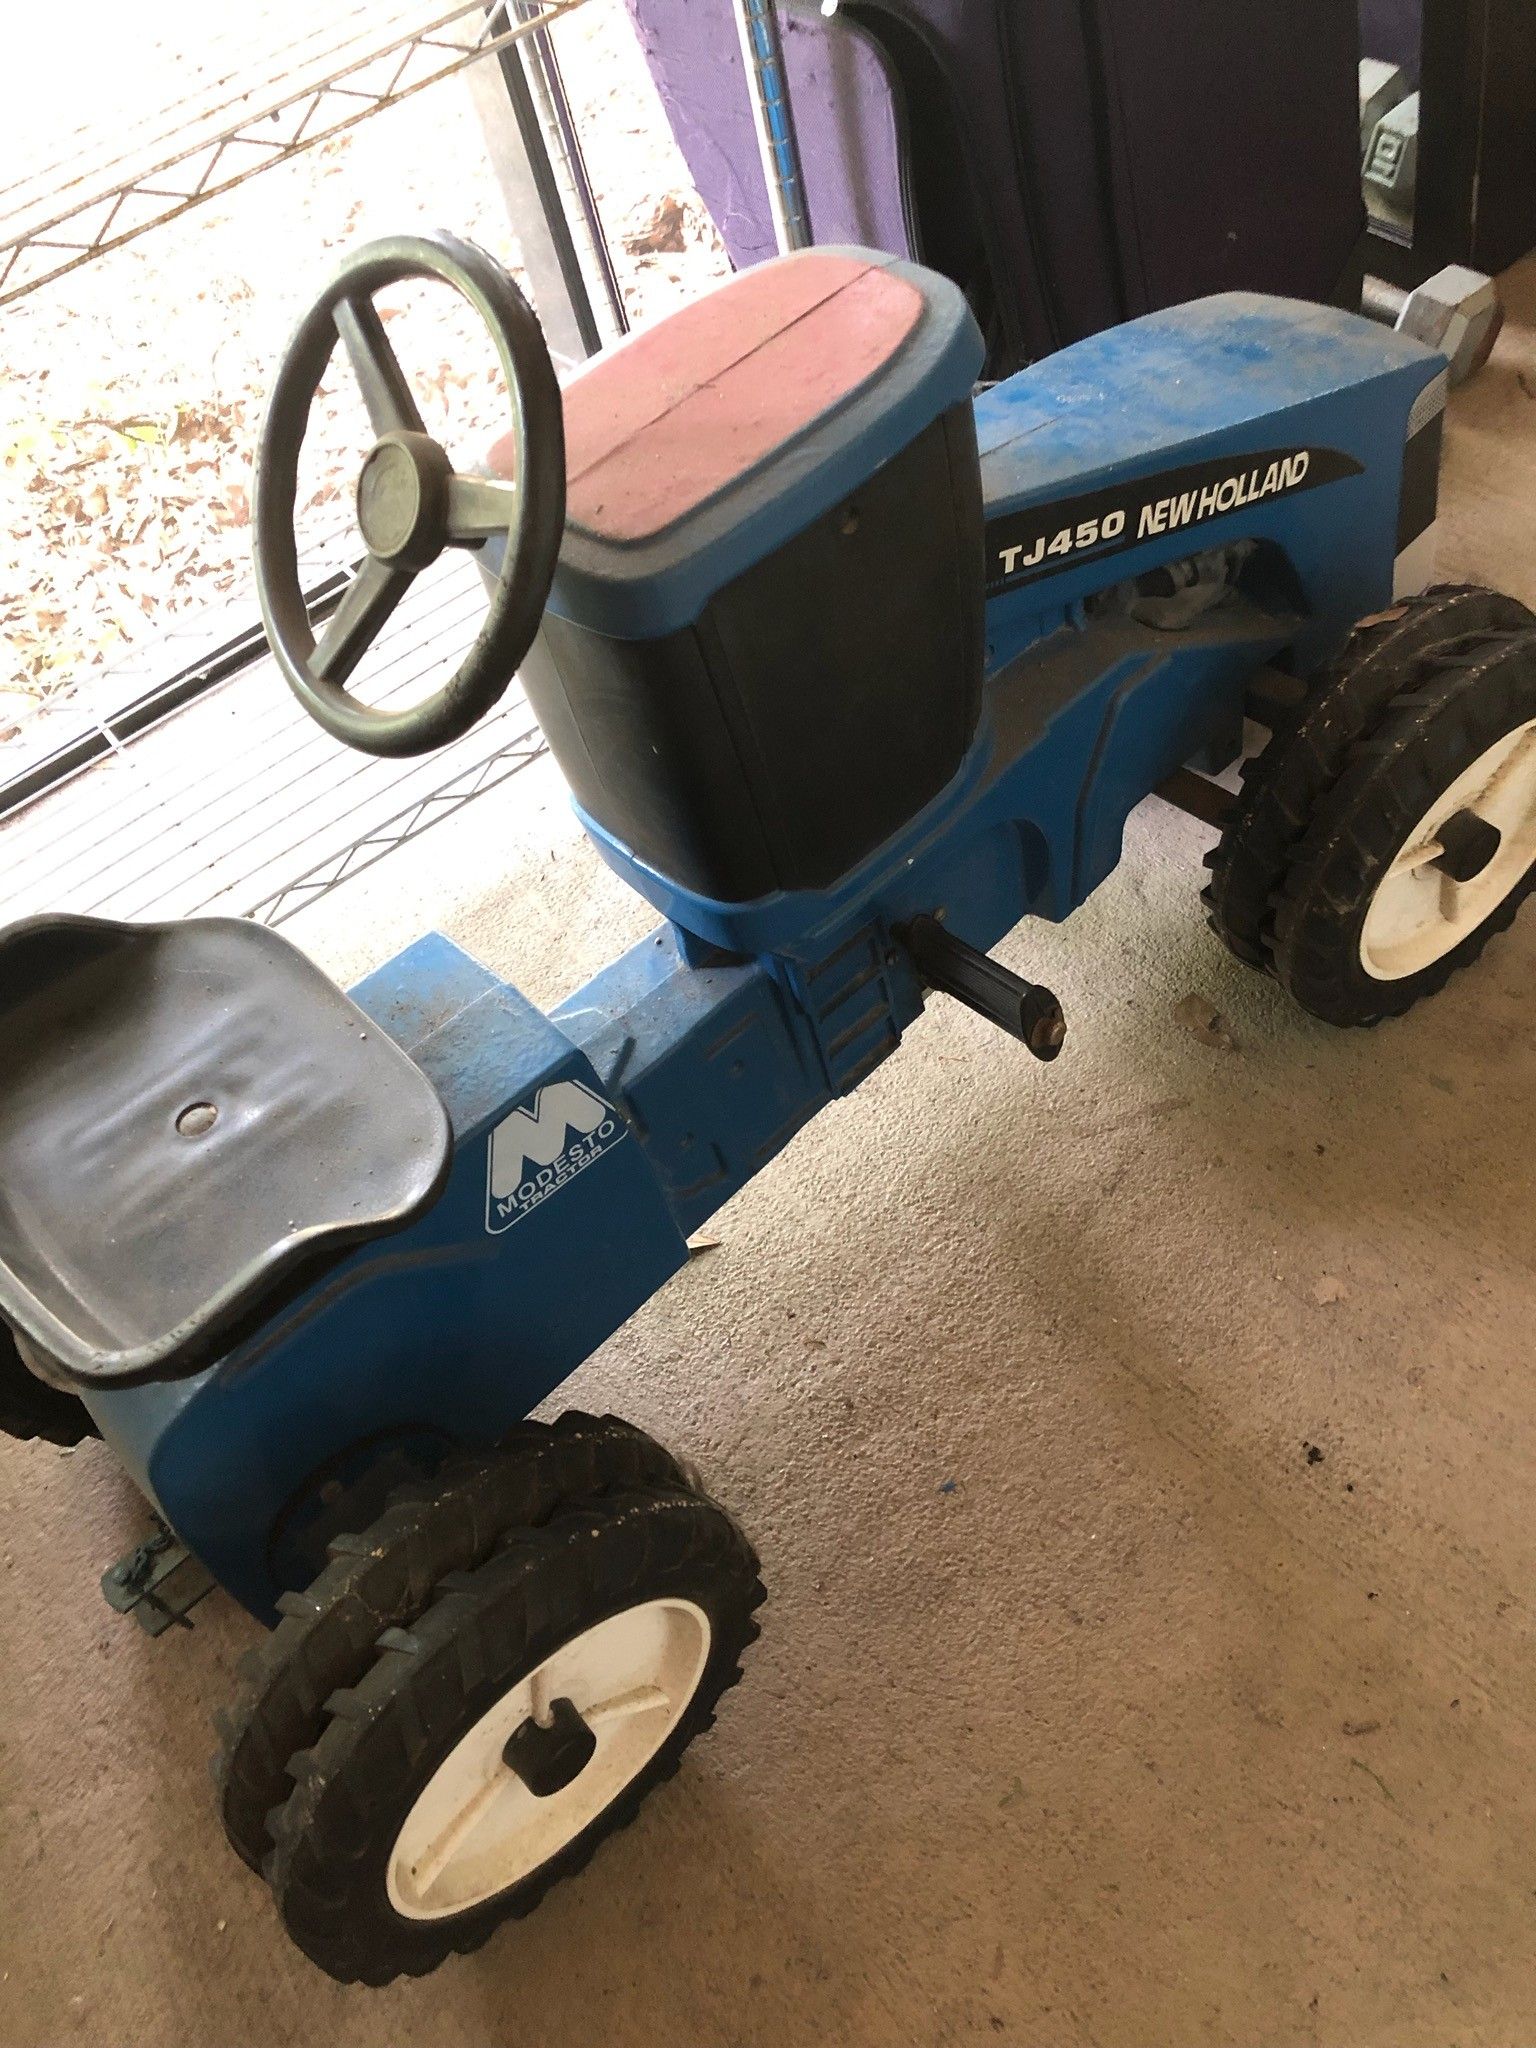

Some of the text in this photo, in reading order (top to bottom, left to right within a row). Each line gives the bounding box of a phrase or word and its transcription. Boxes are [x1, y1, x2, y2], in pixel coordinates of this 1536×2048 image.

[998, 509, 1126, 575] TJ450
[496, 1119, 616, 1219] MODESTO
[518, 1144, 605, 1212] TRACTOR
